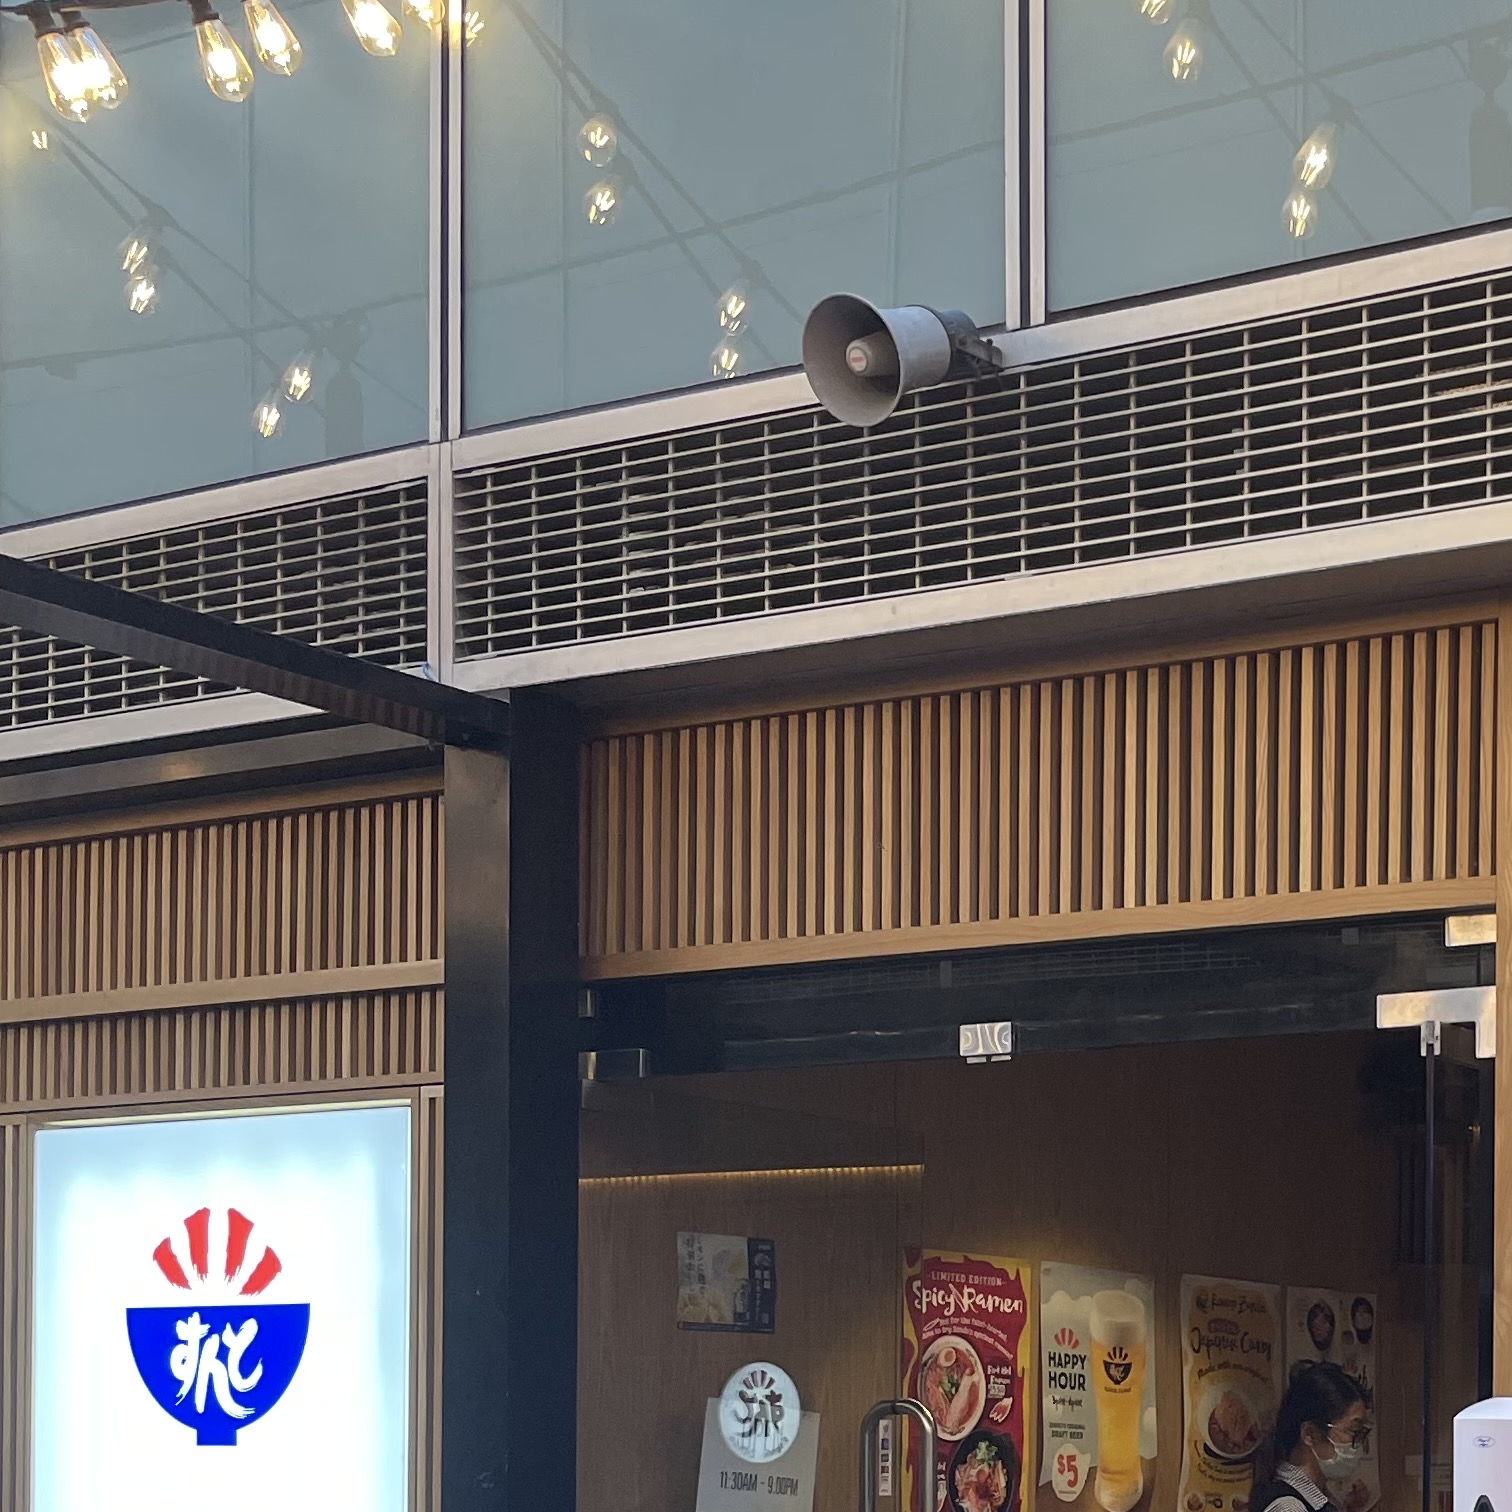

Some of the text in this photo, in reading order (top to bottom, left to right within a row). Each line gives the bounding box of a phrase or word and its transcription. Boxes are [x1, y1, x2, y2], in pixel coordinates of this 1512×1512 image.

[931, 1271, 1002, 1287] LIMITED EDITION
[913, 1280, 1023, 1316] Spicy Ramen
[1048, 1351, 1087, 1370] HAPPY
[1048, 1370, 1087, 1392] HOUR
[1057, 1454, 1079, 1488] $5
